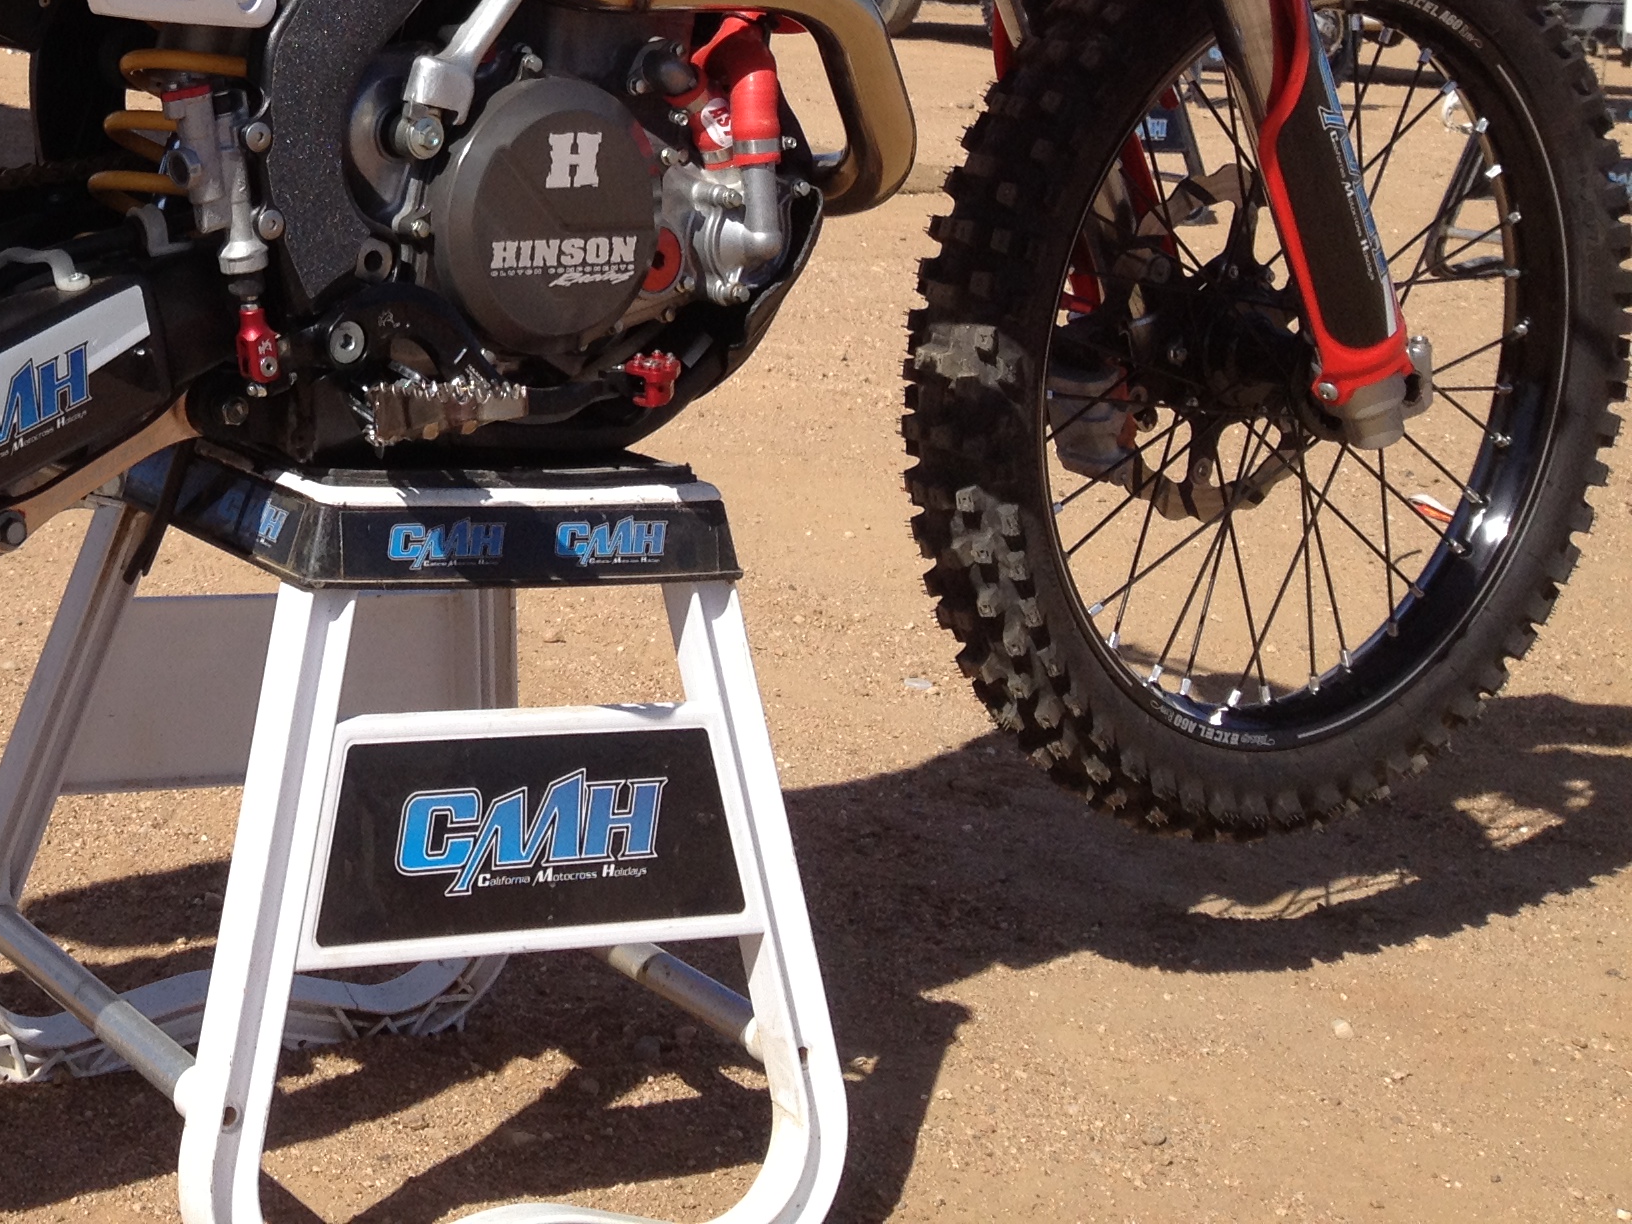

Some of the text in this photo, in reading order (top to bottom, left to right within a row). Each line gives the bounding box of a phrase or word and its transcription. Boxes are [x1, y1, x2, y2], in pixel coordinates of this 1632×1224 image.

[546, 132, 602, 188] H
[490, 236, 637, 270] HINSON
[387, 517, 507, 571] CMH
[555, 514, 669, 567] CMH
[395, 768, 668, 897] CMH
[477, 864, 648, 888] California Motocross Holidays
